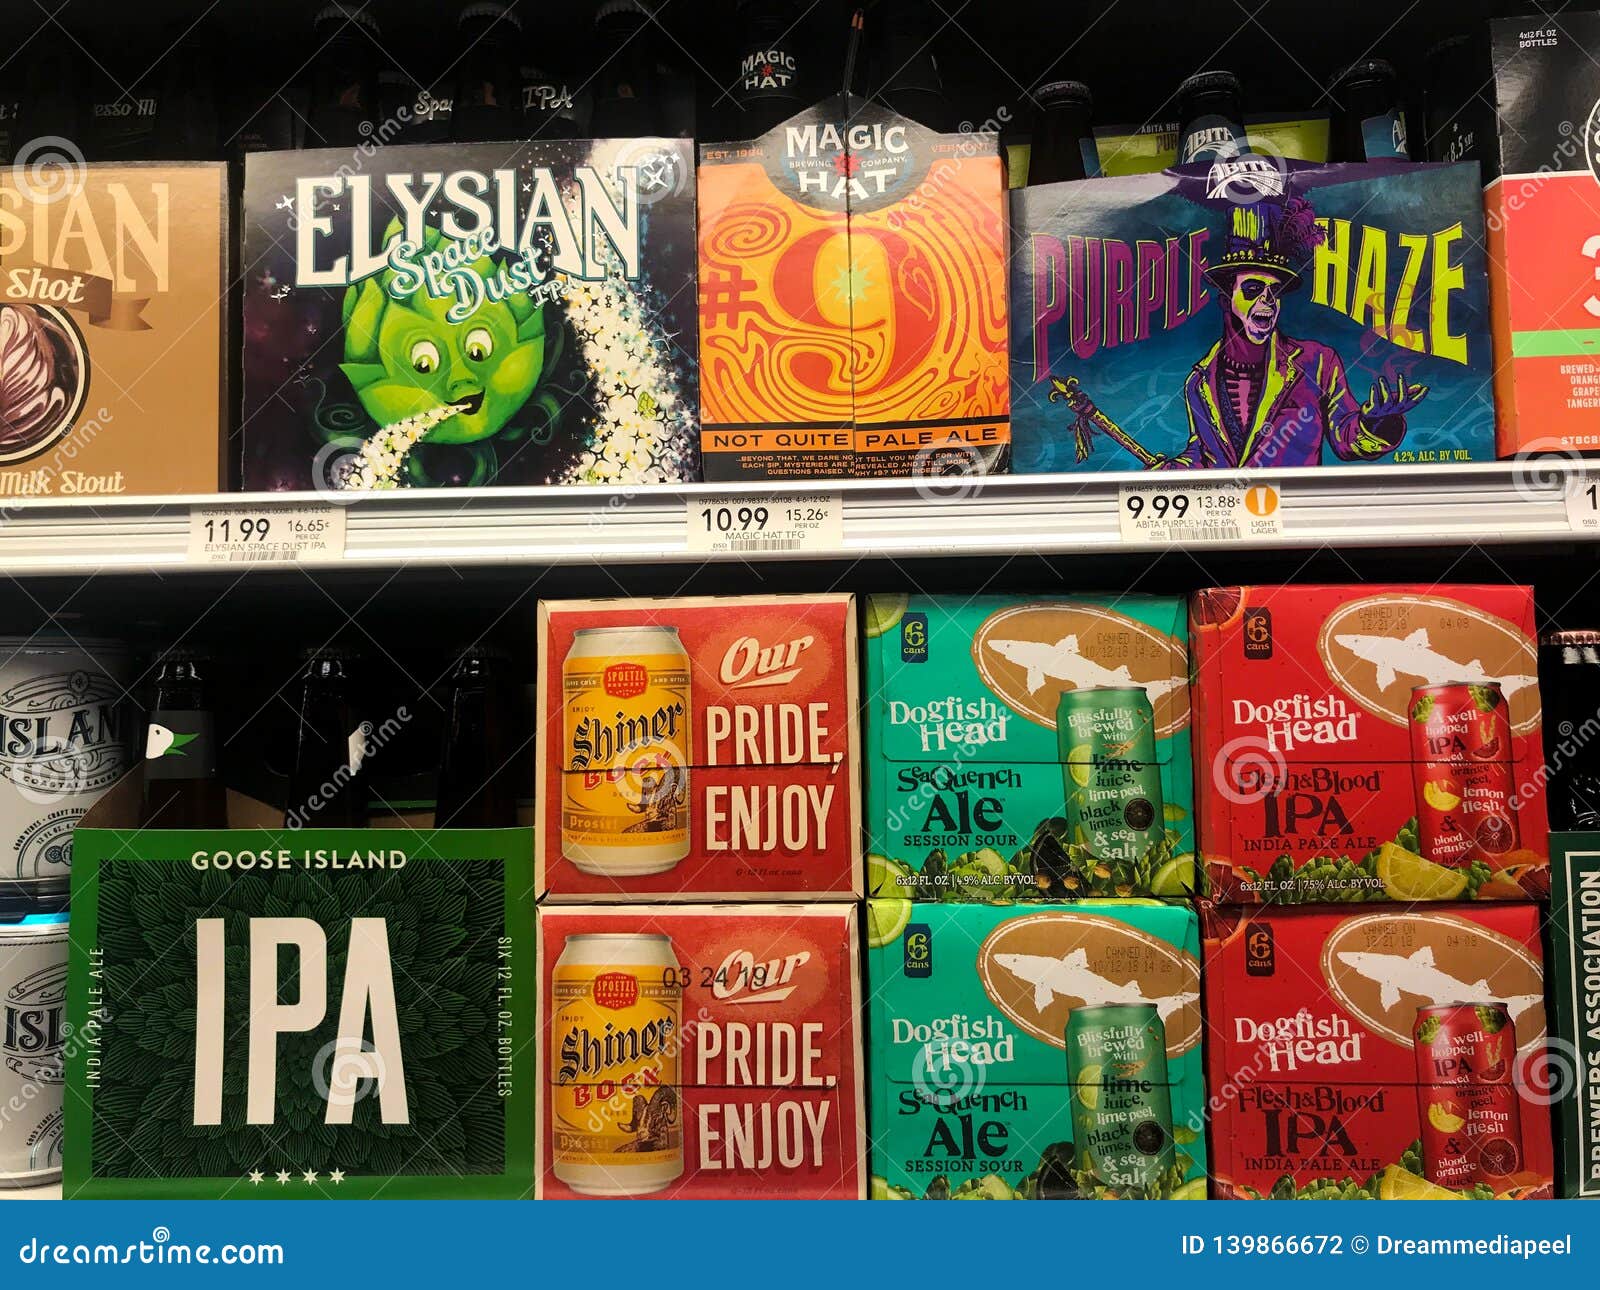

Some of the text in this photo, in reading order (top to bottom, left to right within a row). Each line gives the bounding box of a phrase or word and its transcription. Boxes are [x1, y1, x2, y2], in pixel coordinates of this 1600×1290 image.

[1519, 38, 1558, 48] BOTTLES
[1546, 30, 1556, 38] OZ
[742, 50, 796, 75] MAGIC
[745, 74, 791, 90] HAT
[522, 86, 573, 110] IPA
[785, 123, 909, 158] MAGIC
[1141, 125, 1163, 134] ABITA
[706, 149, 732, 160] EST.
[789, 159, 831, 169] BREWING
[799, 168, 897, 201] HAT
[296, 166, 640, 287] ELYSIAN
[388, 227, 501, 301] Space
[6, 268, 85, 303] Shot
[445, 246, 546, 320] Dust
[531, 274, 582, 308] IPA
[1031, 227, 1211, 382] PURPLE
[1310, 218, 1468, 366] HAZE
[1560, 364, 1594, 375] BREWED
[713, 428, 998, 448] NOT QUITE PALE ALE
[1393, 450, 1473, 463] 4.2% ALC. BY VOL.
[60, 471, 126, 494] Stout
[1126, 494, 1241, 520] 9.99 13.88¢
[204, 518, 330, 543] 11.99 16.65¢
[701, 507, 829, 532] 10.99 15.26¢
[1136, 518, 1238, 529] ABITA PURPLE HAZE 6PK
[1250, 520, 1275, 528] LIGHT
[725, 530, 806, 540] MAGIC HAT TFG
[205, 541, 326, 552] ELYSIAN SPACE DUST IPA
[904, 620, 926, 645] 6
[1246, 616, 1269, 642] 6
[903, 645, 926, 655] cans
[1246, 641, 1270, 651] cans
[719, 635, 814, 685] Our
[607, 670, 645, 683] SPOETZL
[889, 697, 998, 726] Dogfish
[1067, 707, 1133, 727] Blissfully
[1231, 695, 1347, 725] Dogfish
[571, 701, 683, 771] Shiner
[706, 702, 844, 774] PRIDE,
[919, 716, 1008, 752] Head
[1077, 717, 1134, 738] brewed
[1103, 731, 1127, 742] with
[1266, 713, 1358, 752] Head
[1425, 724, 1468, 736] hopped
[1428, 735, 1466, 756] IPA
[583, 750, 673, 791] BOCK
[896, 764, 1022, 793] SeaQuench
[1088, 788, 1118, 802] lime
[1463, 787, 1504, 799] lemon
[706, 784, 835, 851] ENJOY
[921, 790, 1004, 835] Ale
[1079, 800, 1121, 822] black
[1261, 793, 1354, 839] IPA
[1088, 815, 1123, 832] limes
[903, 835, 1018, 847] SESSION SOUR
[1094, 829, 1137, 847] & sea
[1243, 837, 1377, 851] INDIA PALE ALE
[1432, 840, 1474, 855] orange
[1433, 833, 1463, 846] blood
[191, 849, 407, 871] GOOSE ISLAND
[1100, 842, 1138, 860] salt
[896, 874, 1017, 885] 6x12 4.9% BY
[1240, 878, 1363, 892] 6x12 BY
[906, 933, 929, 959] 6
[1248, 932, 1272, 959] 6
[906, 959, 929, 969] cans
[1248, 958, 1272, 968] cans
[662, 966, 768, 988] 03 24 19
[712, 949, 811, 1000] Our
[596, 979, 636, 994] SPOETZL
[86, 948, 104, 1088] INDIA PALE ALE
[193, 917, 410, 1125] IPA
[497, 936, 512, 1097] SIX 12 BOTTLES
[1234, 1012, 1350, 1043] Dogfish
[891, 1013, 1004, 1043] Dogfish
[1077, 1025, 1143, 1047] Blissfully
[559, 1016, 675, 1086] Shiner
[924, 1034, 1015, 1073] Head
[1087, 1036, 1145, 1059] brewed
[1113, 1051, 1138, 1061] with
[1268, 1033, 1362, 1073] Head
[1433, 1058, 1473, 1078] IPA
[897, 1088, 1028, 1116] SeaQuench
[1239, 1086, 1385, 1113] Flesh&Blood
[1096, 1111, 1128, 1126] lime
[1468, 1109, 1509, 1121] lemon
[698, 1100, 831, 1169] ENJOY
[923, 1114, 1009, 1161] Ale
[1087, 1123, 1130, 1147] black
[1263, 1107, 1358, 1158] IPA
[1097, 1141, 1132, 1157] limes
[905, 1160, 1024, 1173] SESSION SOUR
[1102, 1154, 1146, 1172] & sea
[1244, 1157, 1381, 1172] INDIA PALE ALE
[1436, 1162, 1478, 1178] orange
[1438, 1155, 1467, 1169] blood
